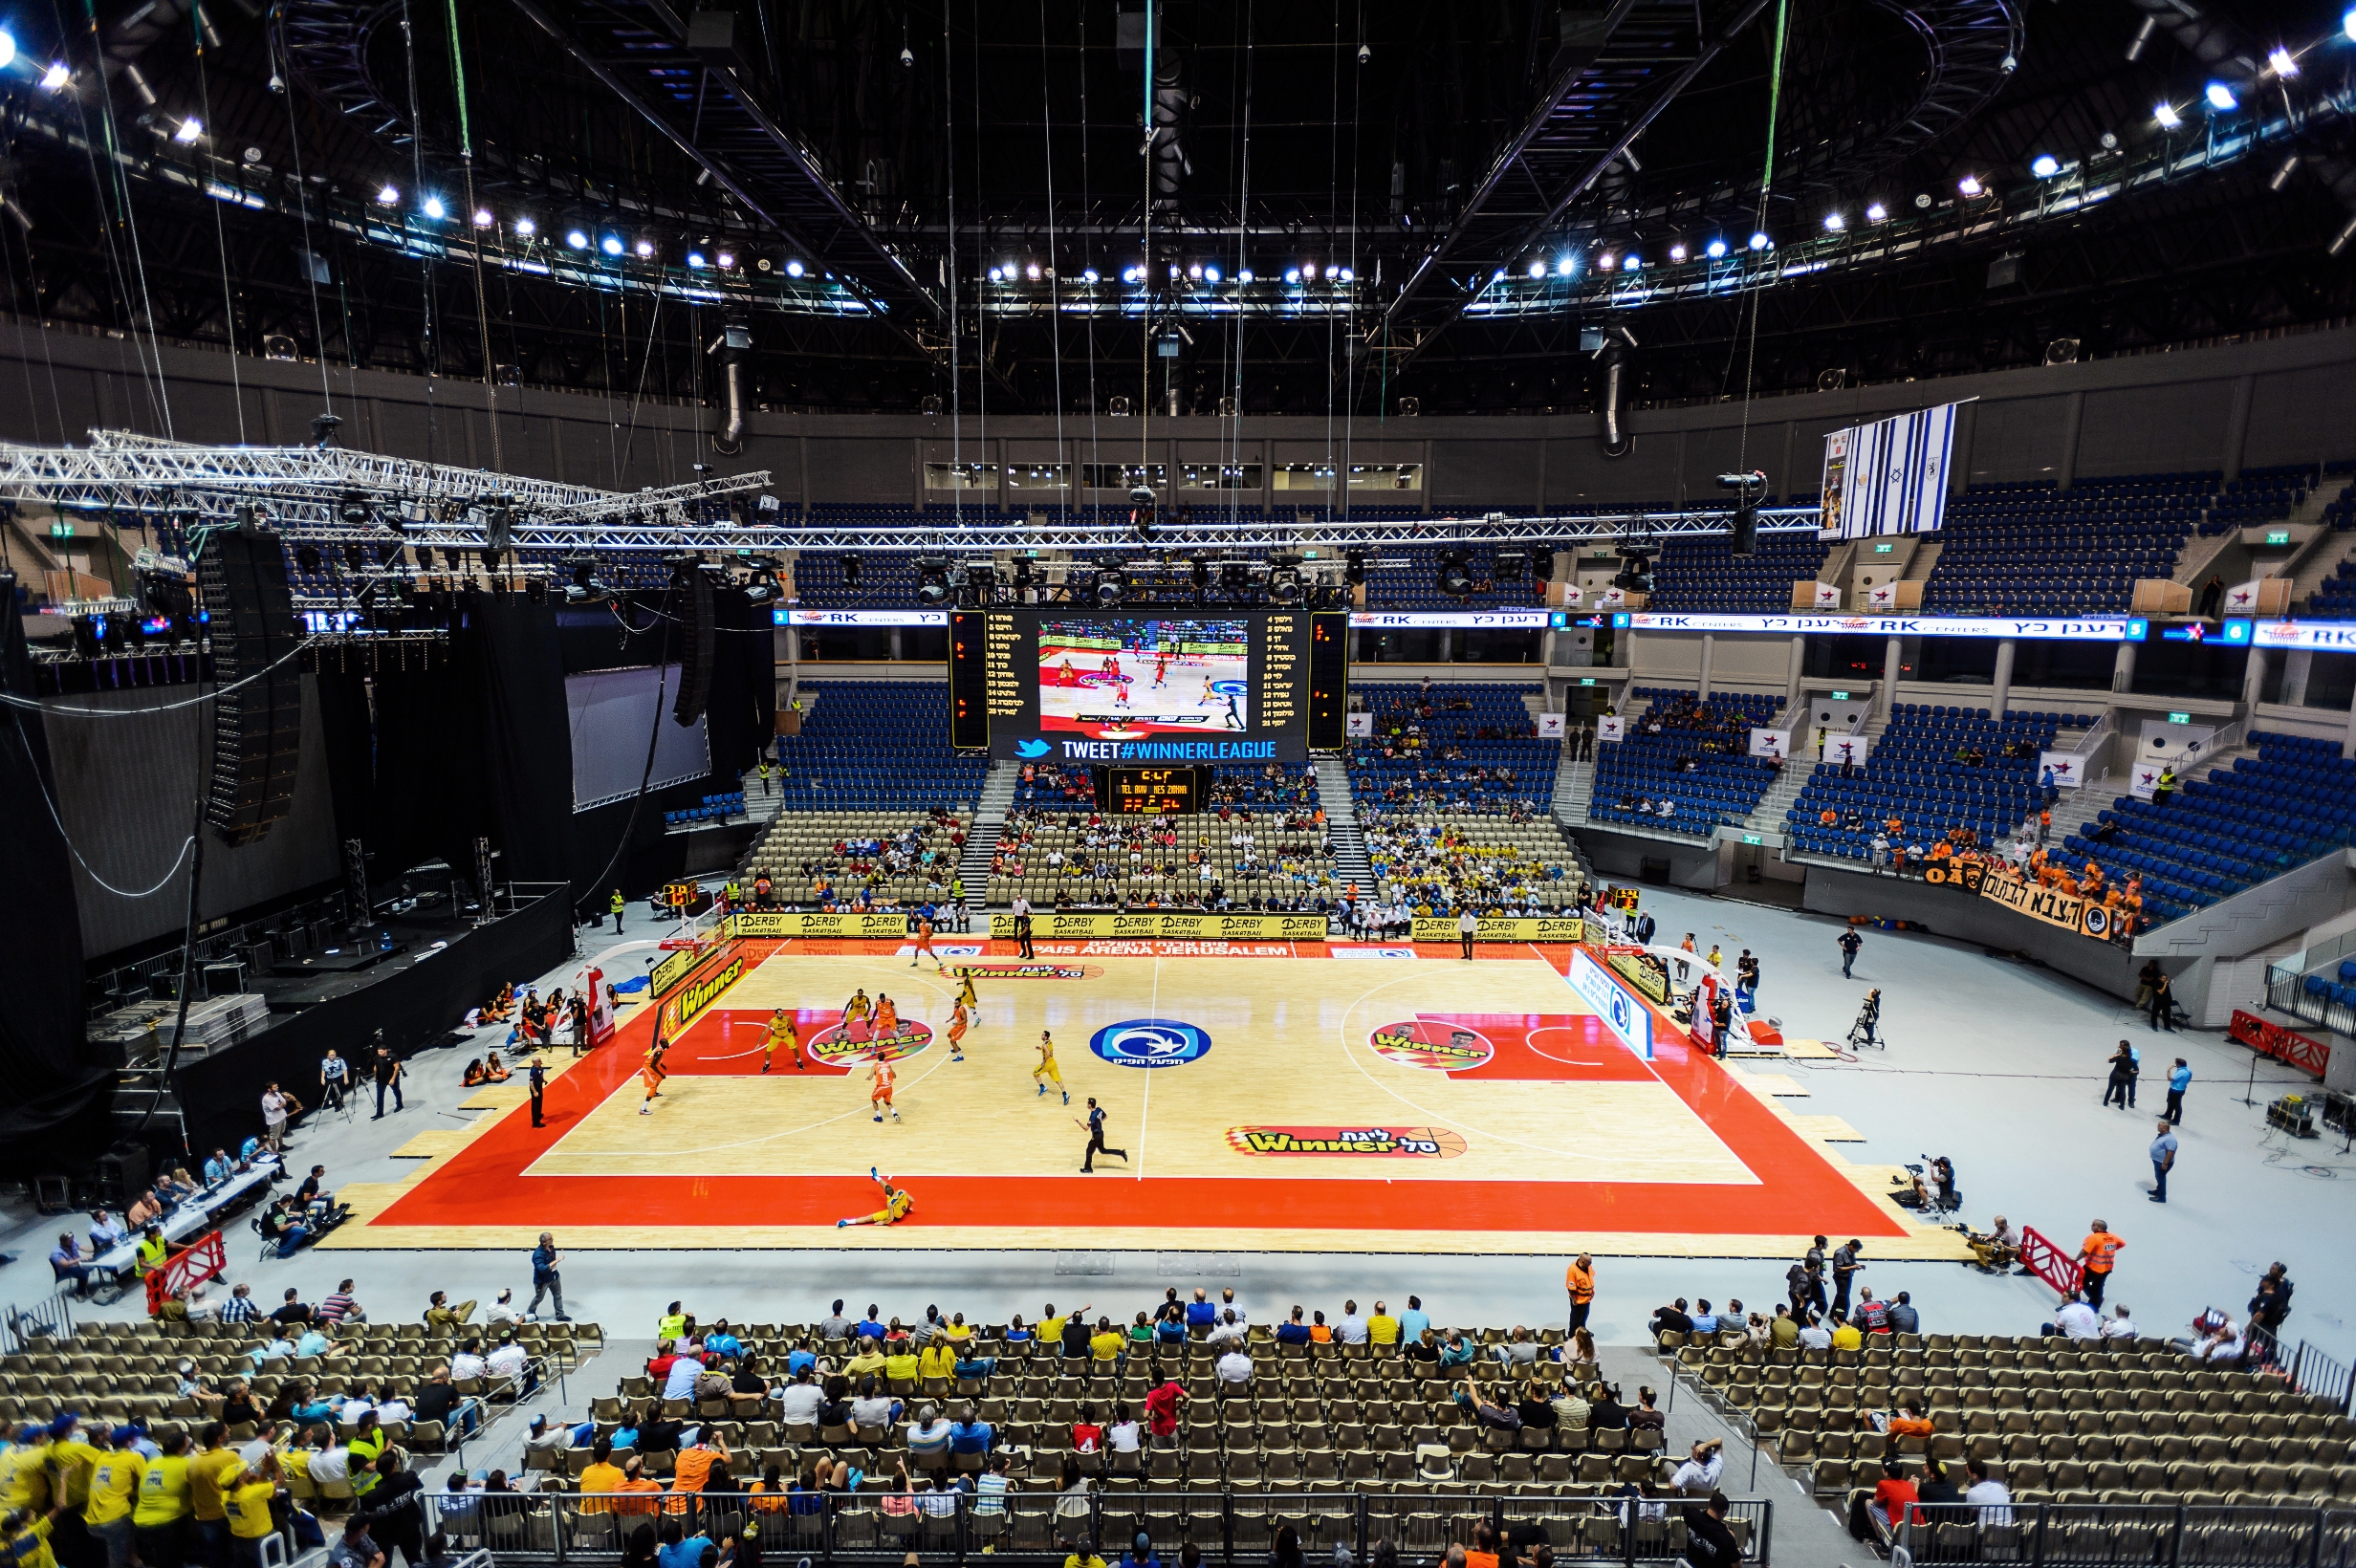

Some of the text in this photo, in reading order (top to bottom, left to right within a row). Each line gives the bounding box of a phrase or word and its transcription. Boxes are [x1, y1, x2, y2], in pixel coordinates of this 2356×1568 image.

[776, 613, 784, 621] 2
[831, 613, 859, 622] RK
[1383, 616, 1412, 624] RK
[1472, 616, 1538, 625] רענן כץ
[1554, 615, 1561, 624] 4
[1617, 617, 1625, 625] 5
[1660, 617, 1691, 627] RK
[1762, 619, 1787, 628] כץ
[1880, 621, 1922, 632] RK
[2014, 622, 2125, 635] רענן כץ
[2130, 622, 2141, 636] 5
[2229, 625, 2242, 639] 6
[2313, 629, 2356, 644] RK
[1062, 740, 1276, 760] TWEET#WINNERLEAGUE
[1121, 785, 1132, 795] TEL
[2030, 891, 2082, 926] הצבא
[741, 915, 783, 927] DERBY
[801, 915, 843, 927] DERBY
[862, 915, 904, 927] DERBY
[993, 915, 1035, 927] DEY
[1053, 916, 1095, 927] DERBY
[1113, 916, 1155, 927] DERBY
[1161, 916, 1203, 928] DERBY
[1221, 917, 1263, 929] DERBY
[1280, 917, 1323, 929] DERBY
[1415, 918, 1458, 930] DERBY
[1476, 919, 1518, 931] DERBY
[1537, 919, 1580, 931] DERBY
[1032, 946, 1288, 956] PAIS ARENA JERUSALEM
[655, 958, 676, 986] DERBY
[1638, 965, 1665, 990] DERBY
[681, 956, 743, 1025] Winner
[813, 1034, 931, 1055] Winner
[1374, 1033, 1489, 1058] Winner
[1341, 1129, 1389, 1142] ליגת
[1245, 1132, 1398, 1153] Winner
[1398, 1137, 1440, 1153] סל
[1080, 1436, 1095, 1454] 4
